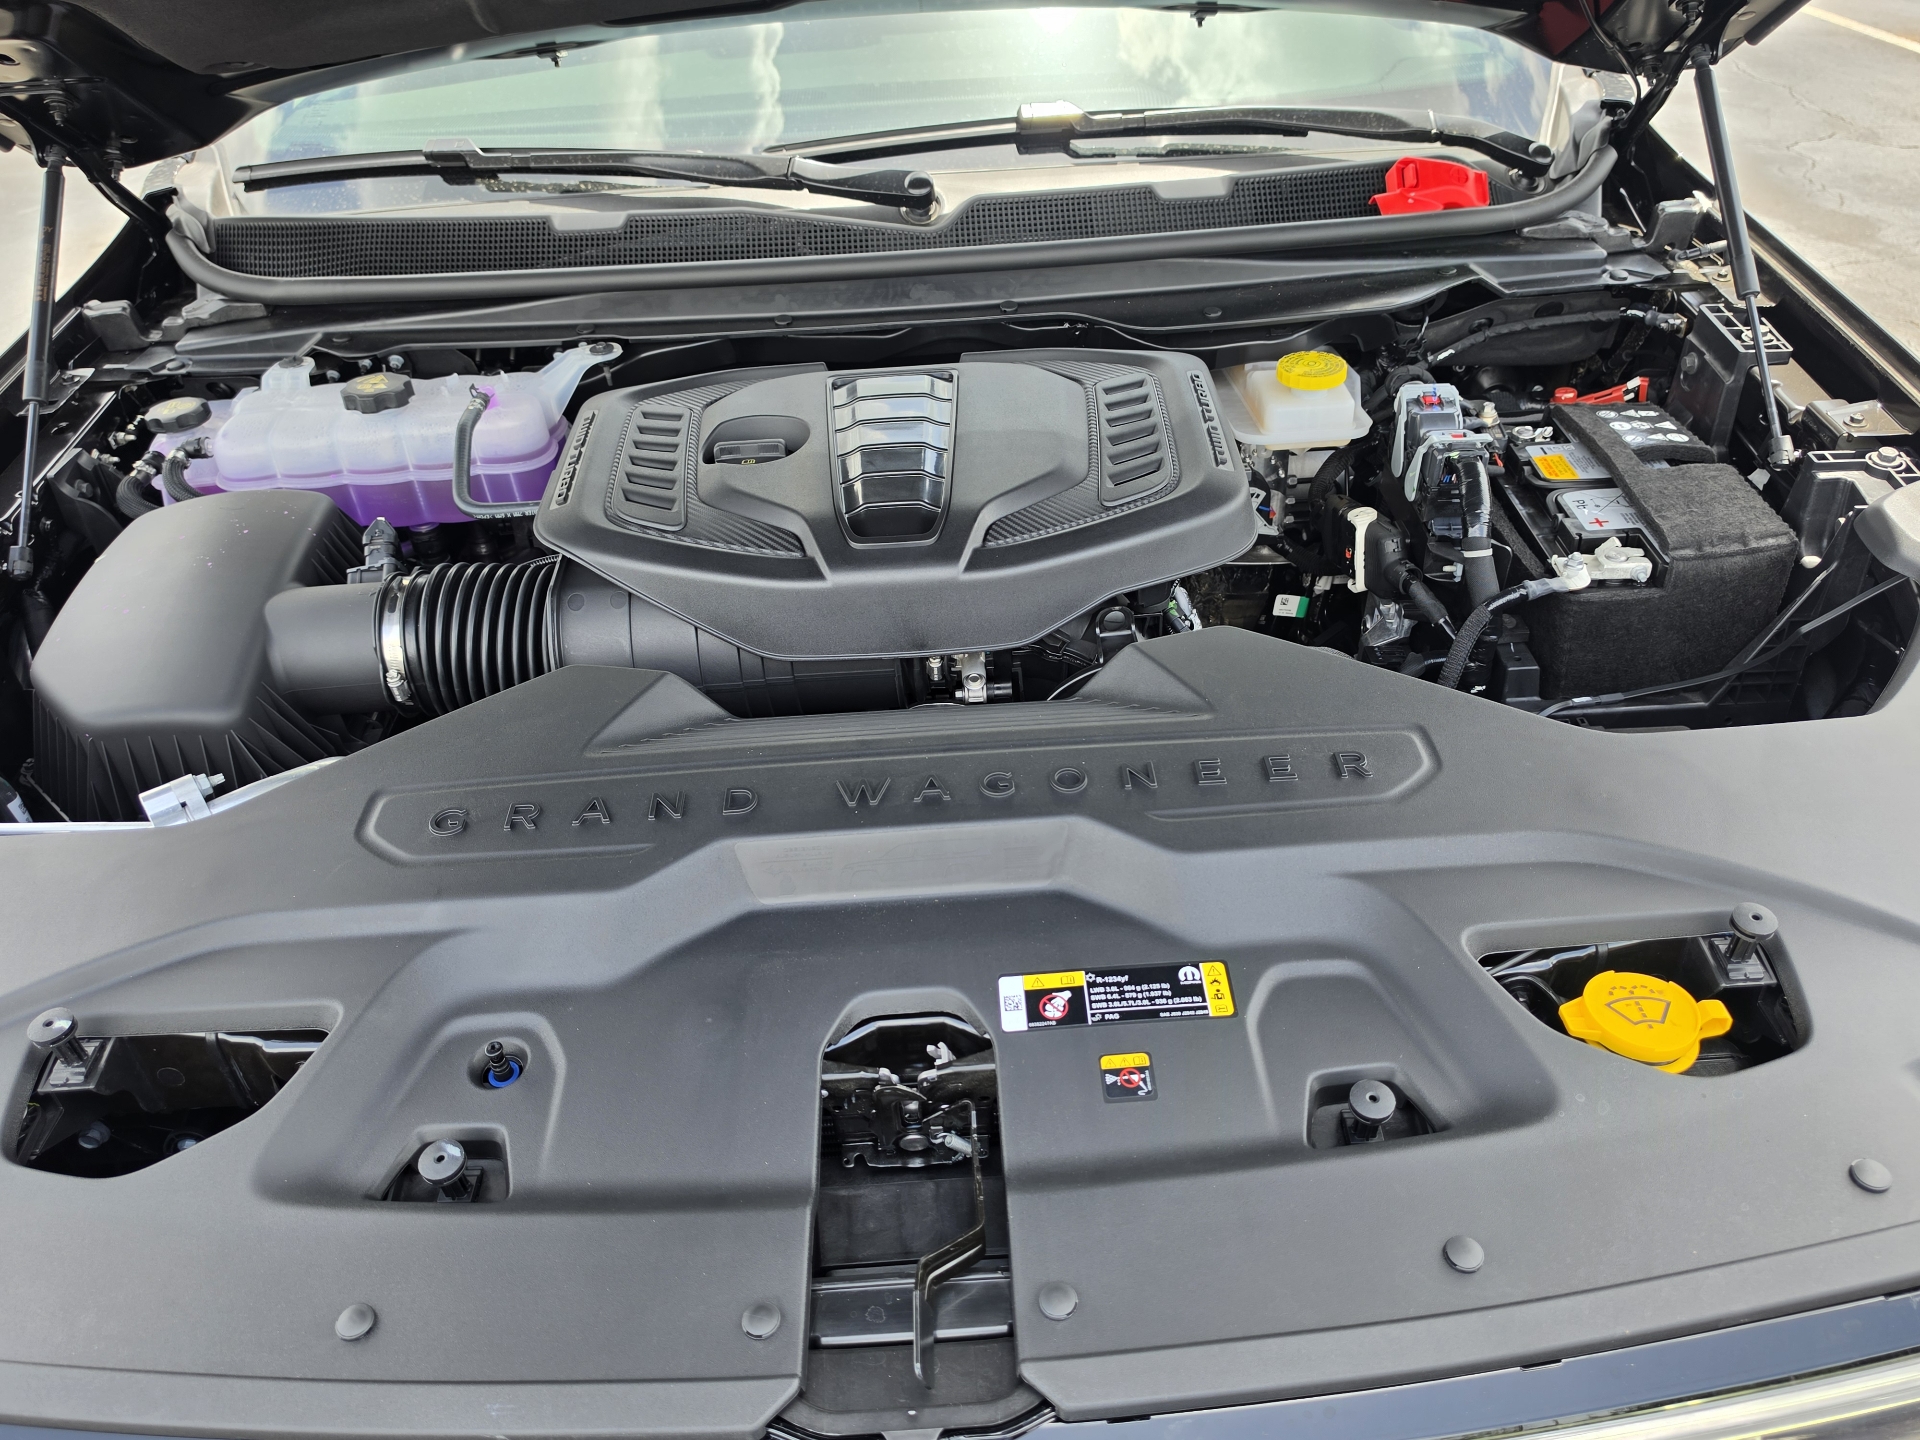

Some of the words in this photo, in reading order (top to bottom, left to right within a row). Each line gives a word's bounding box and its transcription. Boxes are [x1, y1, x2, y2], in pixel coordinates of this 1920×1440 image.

[1189, 373, 1215, 424] TURBO
[1206, 424, 1228, 468] TWIN
[428, 786, 760, 837] GRAND
[835, 750, 1374, 808] WAGONEER
[1096, 975, 1129, 983] R-1234yf
[1104, 1012, 1120, 1020] PAG
